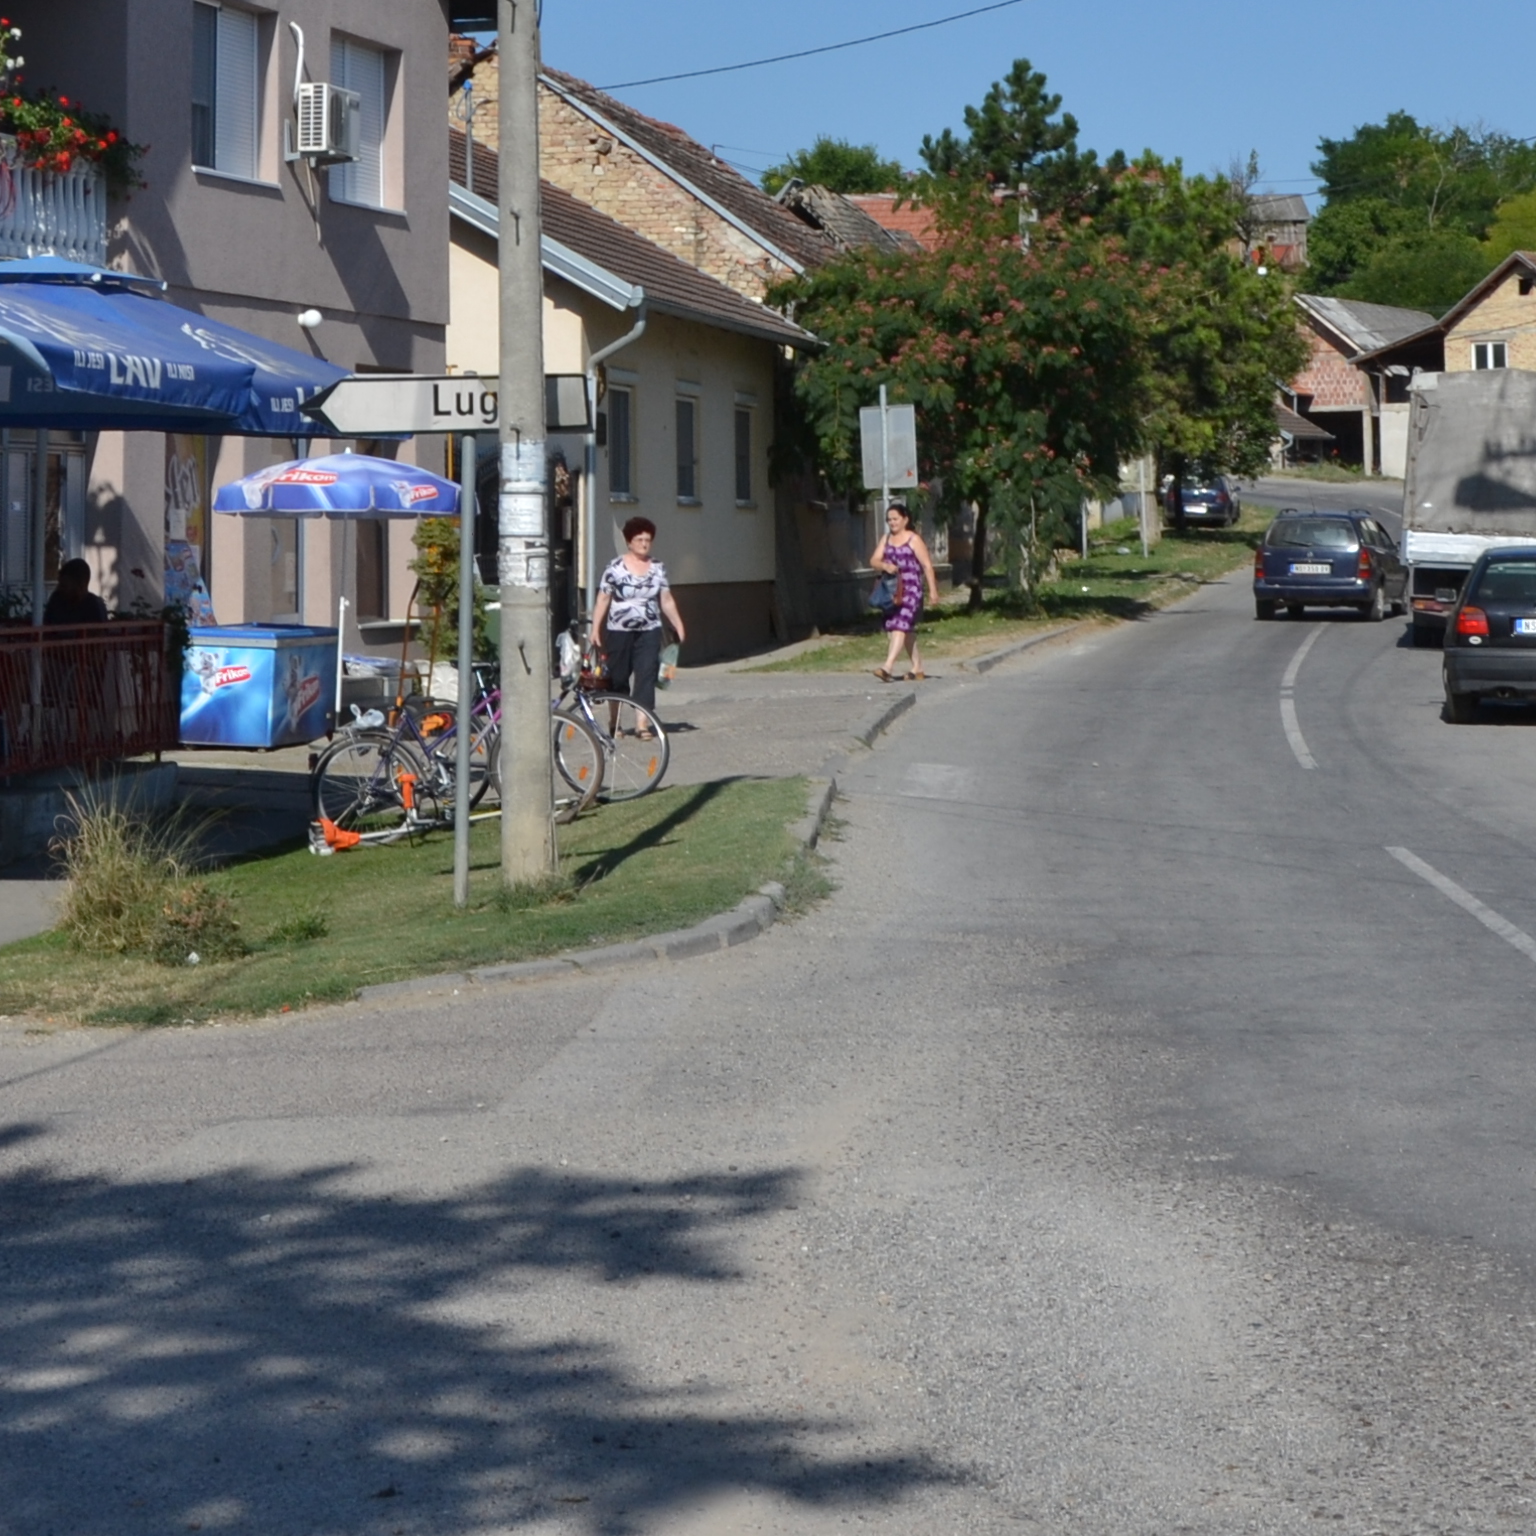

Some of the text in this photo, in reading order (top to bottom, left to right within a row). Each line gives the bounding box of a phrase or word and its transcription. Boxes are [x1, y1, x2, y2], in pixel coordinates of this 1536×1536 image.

[74, 349, 195, 390] ILI JESI LAV ILI NISI
[432, 383, 499, 424] Lug
[276, 470, 338, 484] rikom
